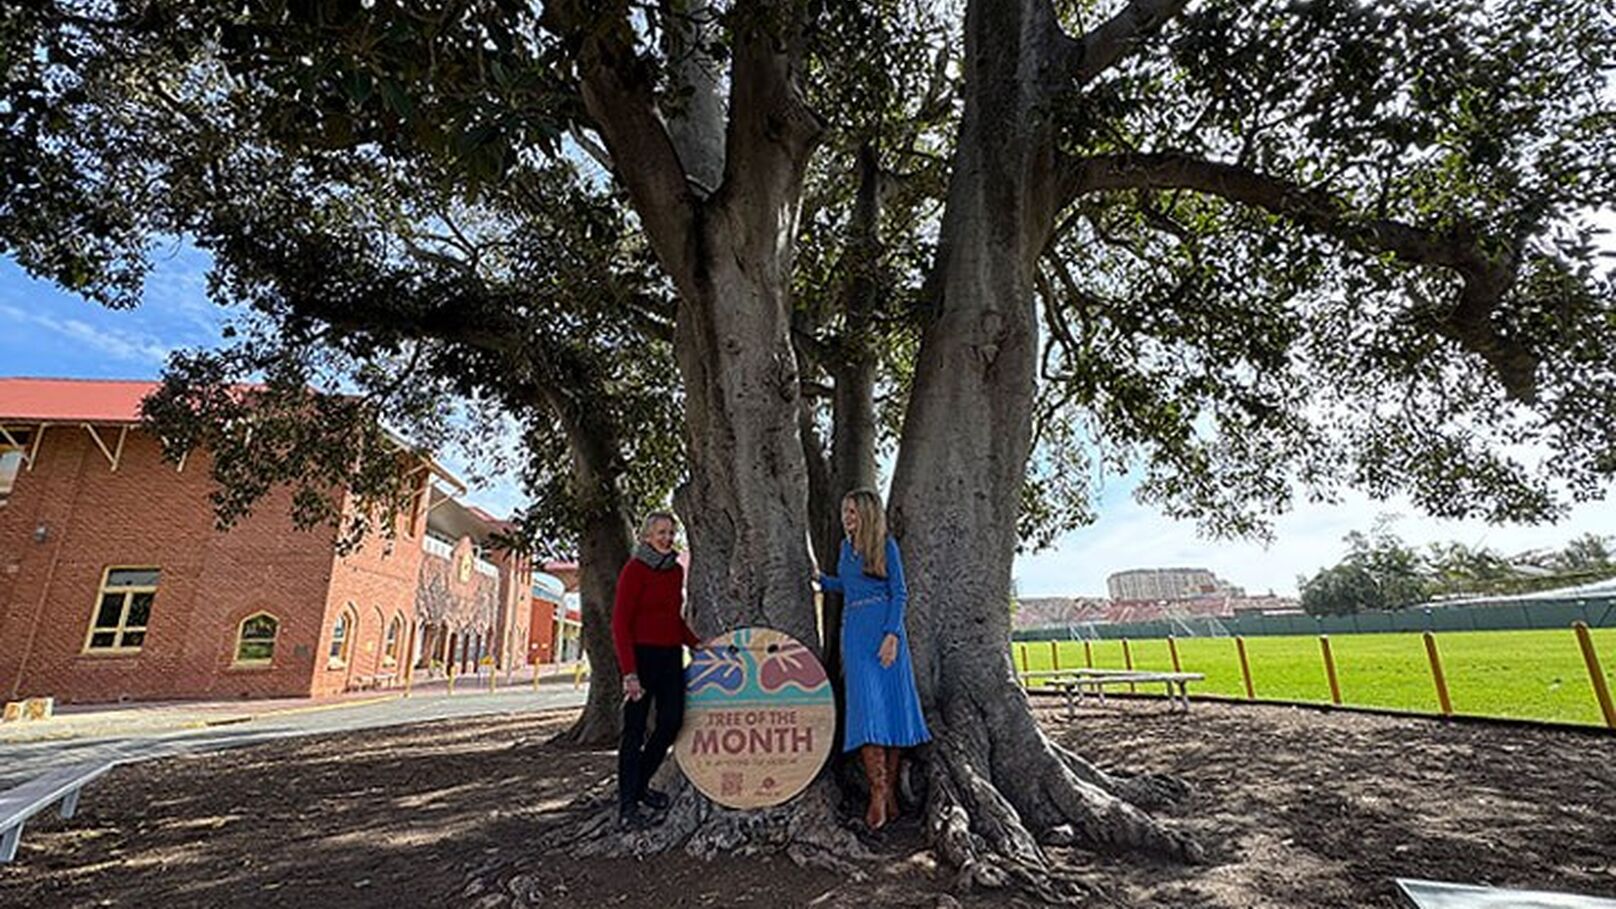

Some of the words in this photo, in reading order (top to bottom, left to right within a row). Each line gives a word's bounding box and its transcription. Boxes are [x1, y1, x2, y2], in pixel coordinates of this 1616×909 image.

[707, 712, 741, 726] TREE
[745, 711, 767, 725] OF
[770, 711, 798, 725] THE
[692, 728, 813, 755] MONTH
